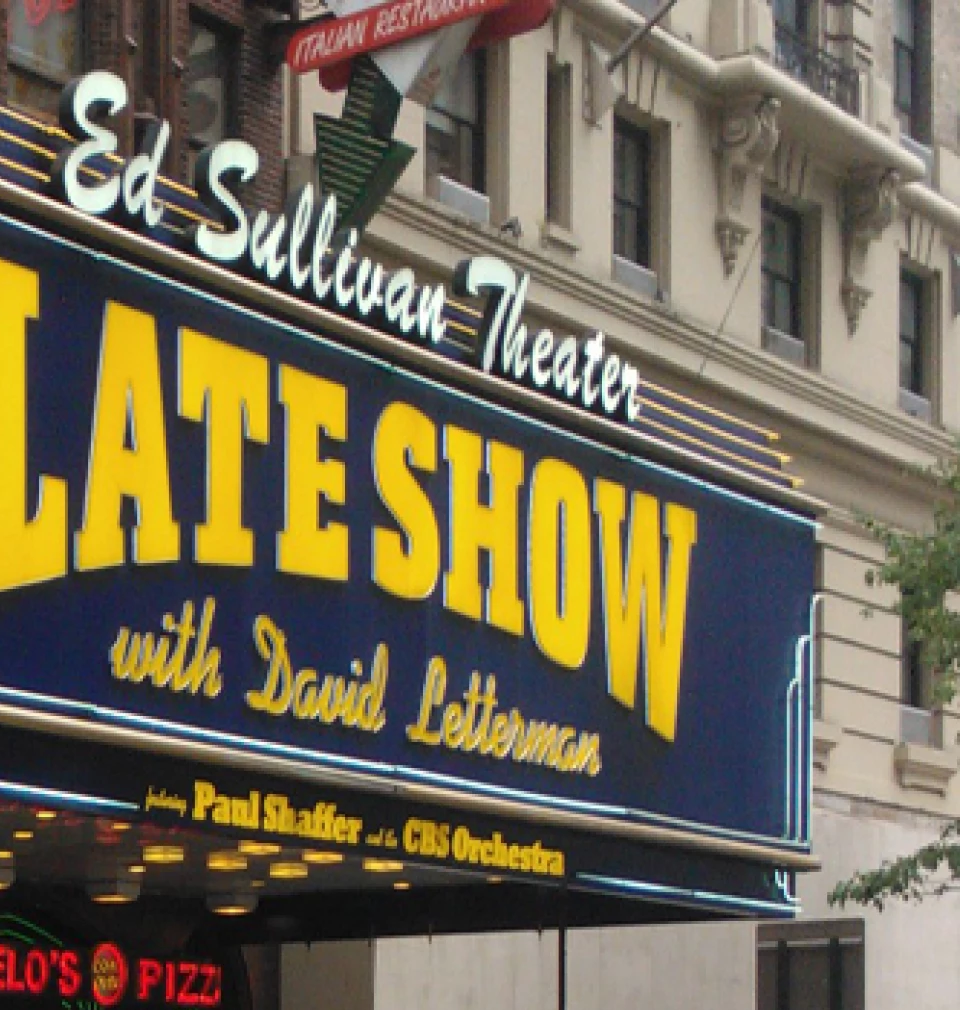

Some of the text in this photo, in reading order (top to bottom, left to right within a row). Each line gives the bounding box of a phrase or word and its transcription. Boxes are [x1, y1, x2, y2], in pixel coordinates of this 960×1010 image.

[293, 0, 486, 67] ITALIAN RESTAUR
[60, 70, 641, 420] Ed Sullivan Theater
[372, 401, 698, 743] SHOW
[109, 596, 603, 777] with David Letterman
[192, 779, 261, 829] Paul
[263, 793, 364, 844] Shaffer
[402, 816, 450, 859] CBS
[452, 825, 566, 878] Orchestra
[135, 957, 222, 1007] PIZZ
